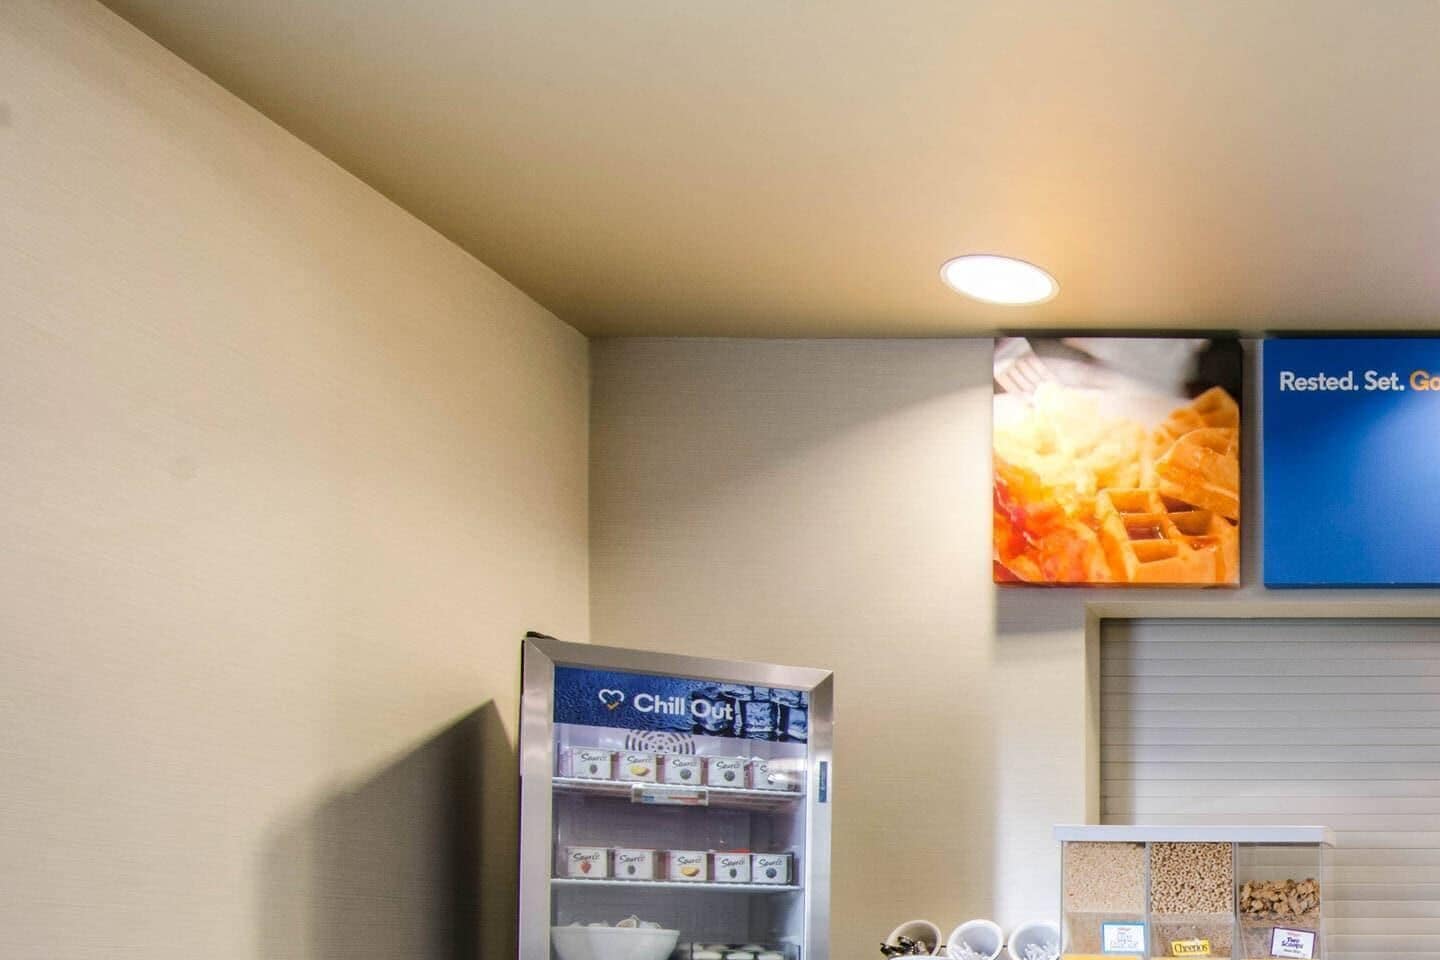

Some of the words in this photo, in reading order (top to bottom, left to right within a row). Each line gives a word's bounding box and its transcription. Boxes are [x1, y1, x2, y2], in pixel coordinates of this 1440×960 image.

[1280, 370, 1359, 391] Rested.
[1364, 370, 1405, 391] Set.
[634, 693, 685, 715] Chill
[691, 699, 733, 720] Out
[1174, 943, 1208, 953] Cheerios
